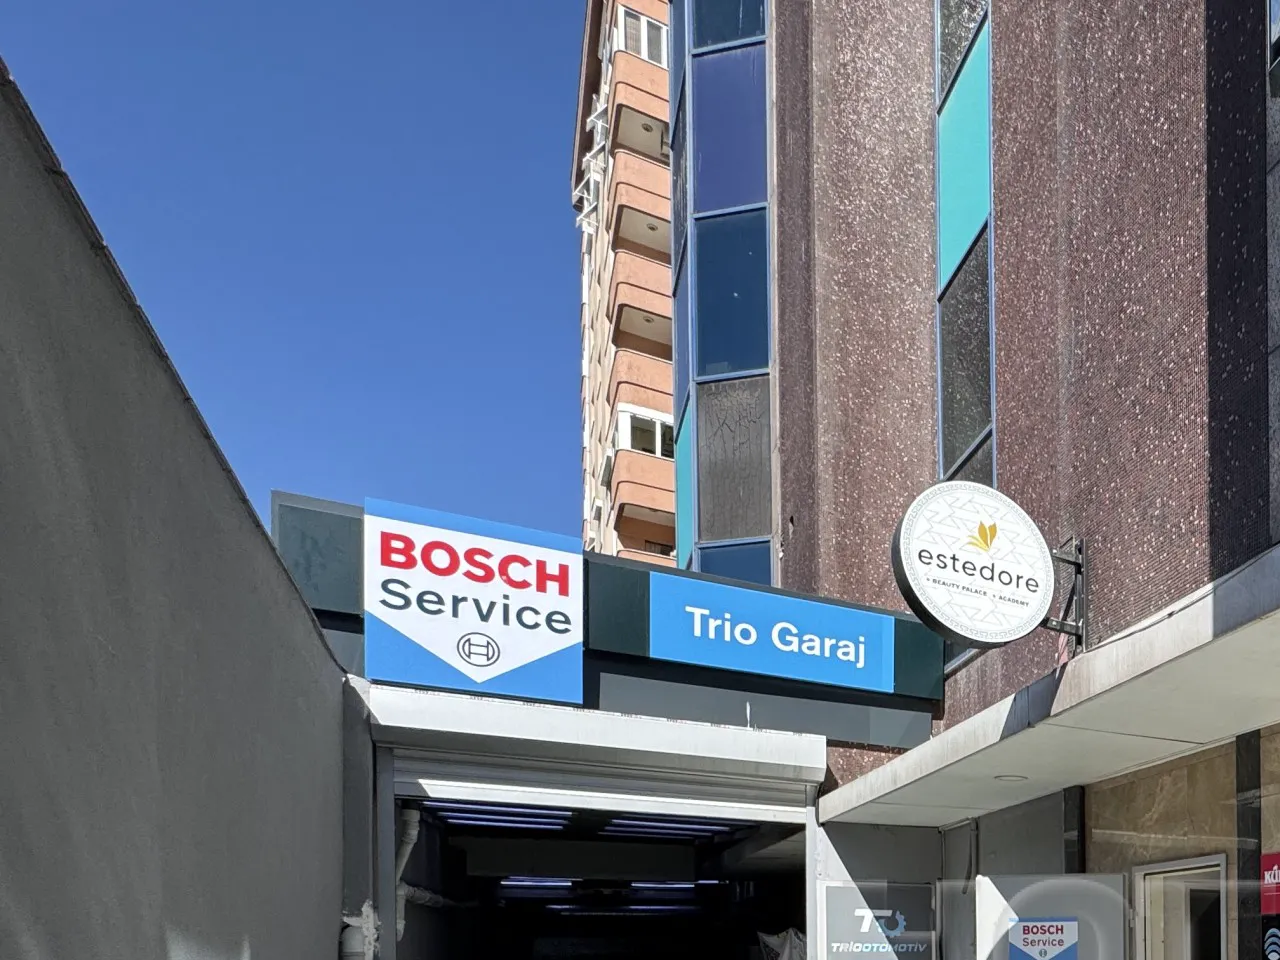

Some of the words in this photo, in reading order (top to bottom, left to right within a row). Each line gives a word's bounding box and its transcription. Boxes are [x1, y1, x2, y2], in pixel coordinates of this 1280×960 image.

[379, 531, 570, 597] BOSCH
[917, 548, 1040, 594] estedore
[379, 578, 573, 635] Service
[932, 578, 961, 590] BEAUTY
[962, 585, 988, 596] PALACE
[999, 595, 1030, 607] ACADEMY
[685, 604, 758, 646] Trio
[771, 620, 867, 669] Garaj
[1022, 924, 1064, 935] BOSCH
[1022, 936, 1064, 947] Service
